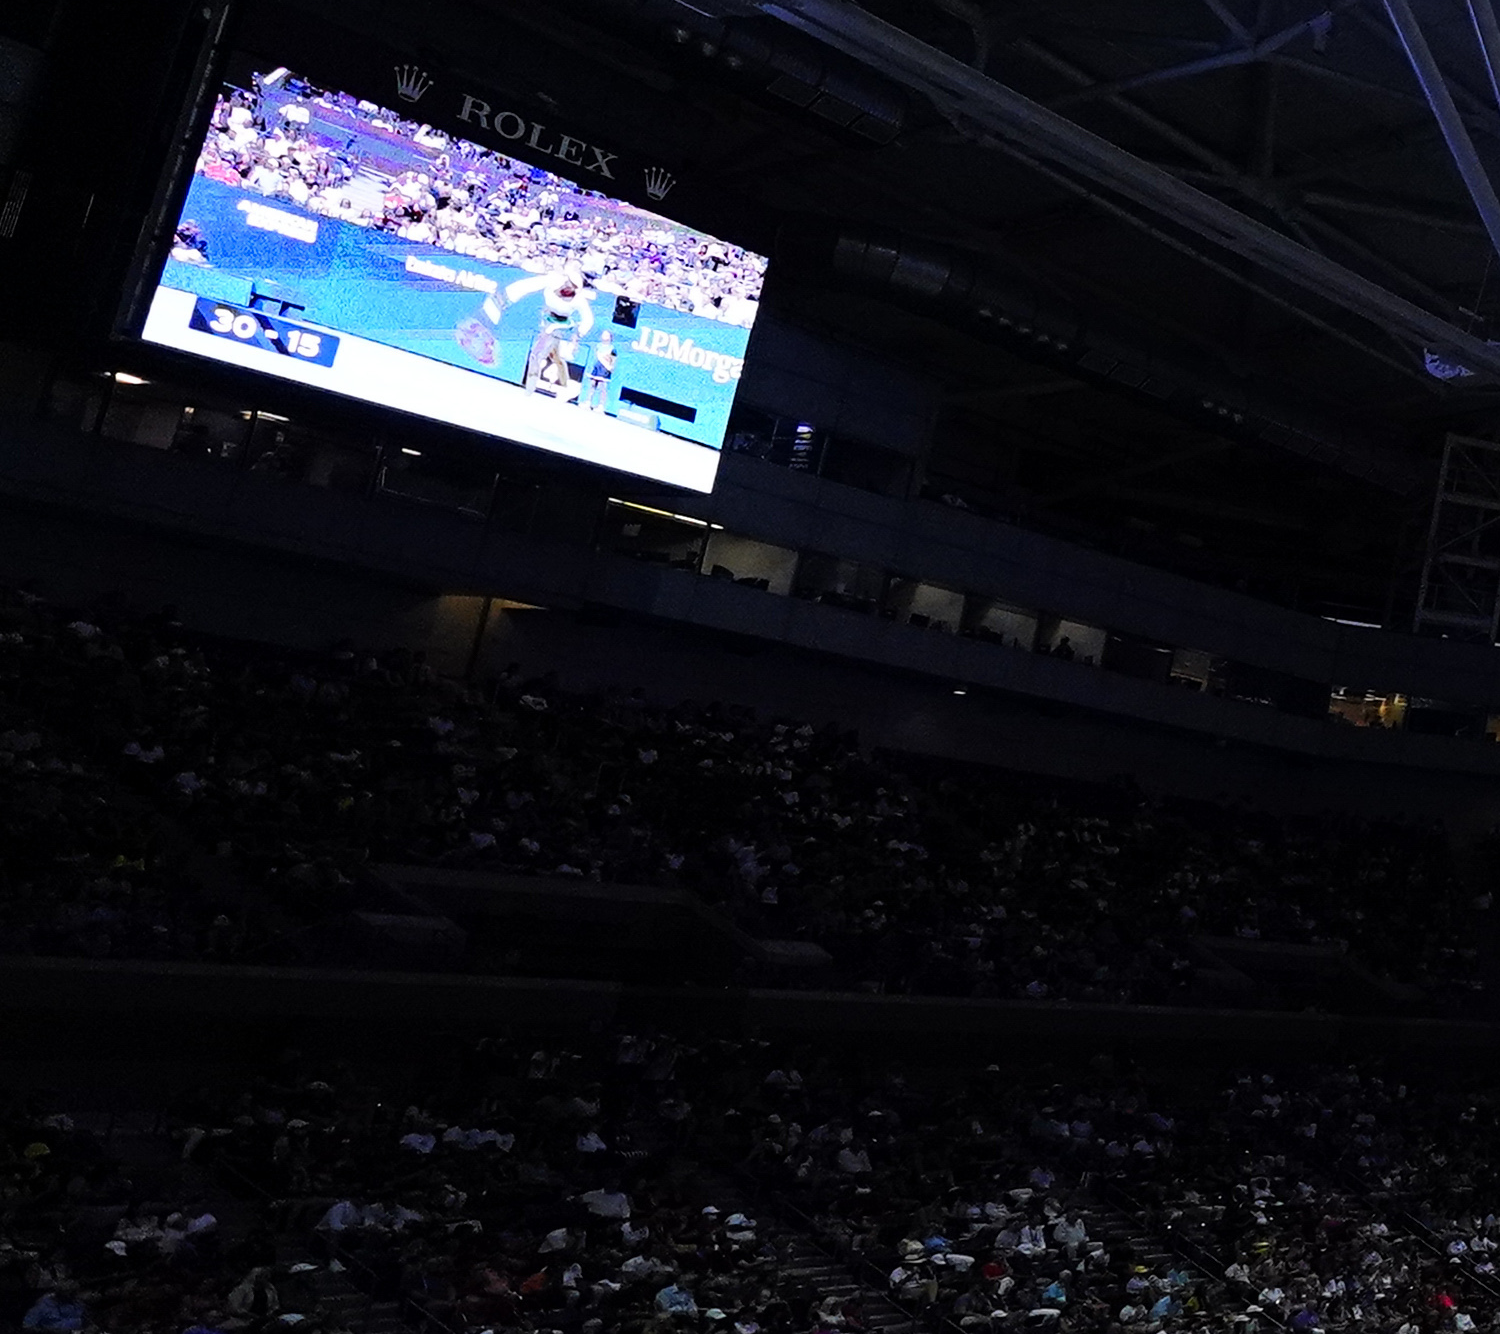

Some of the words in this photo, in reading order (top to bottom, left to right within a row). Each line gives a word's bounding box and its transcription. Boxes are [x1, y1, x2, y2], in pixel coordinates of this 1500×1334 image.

[456, 93, 619, 180] ROLEX
[209, 308, 258, 340] 30
[286, 330, 321, 358] 15
